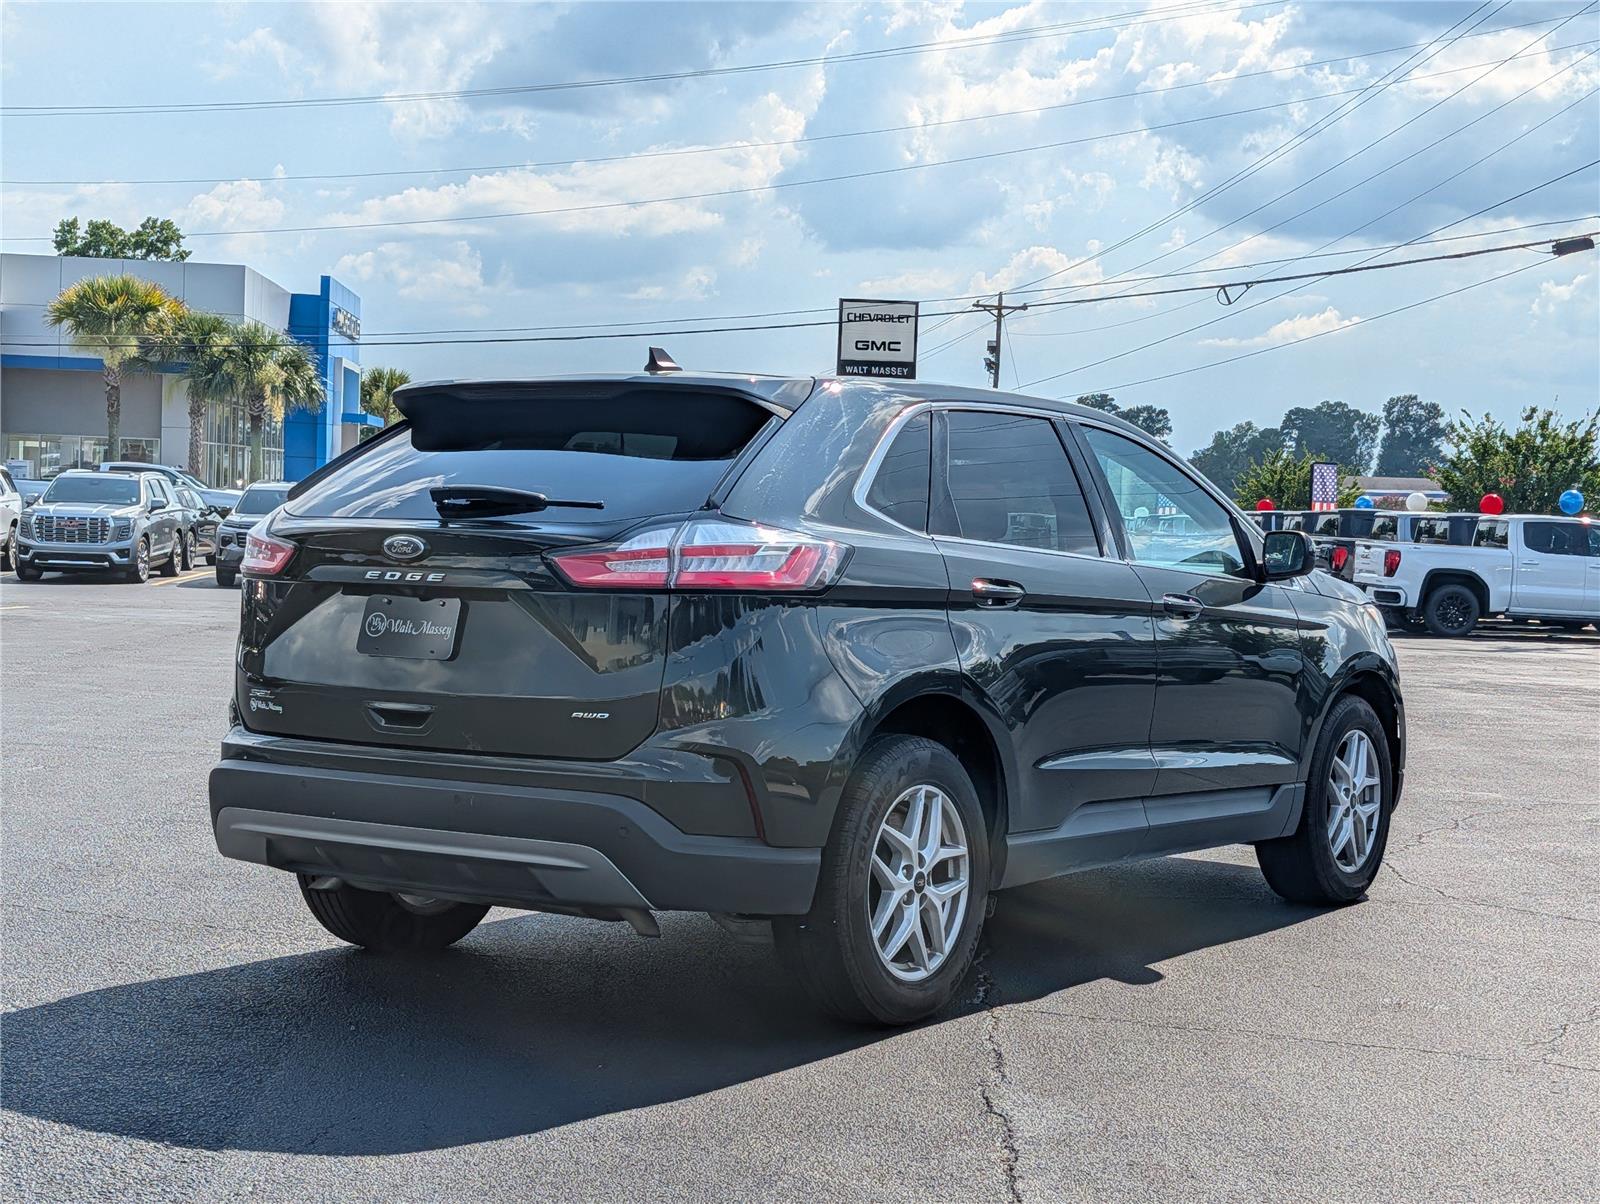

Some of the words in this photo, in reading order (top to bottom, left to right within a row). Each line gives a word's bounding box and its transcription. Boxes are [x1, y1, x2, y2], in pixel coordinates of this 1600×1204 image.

[847, 313, 910, 324] CHEVROLET
[855, 340, 901, 351] GMC
[845, 365, 868, 375] WALT
[871, 367, 909, 375] MASSEY
[391, 540, 413, 553] Ford
[364, 571, 446, 582] EDGE
[387, 618, 412, 632] Walt
[411, 620, 452, 640] Massey
